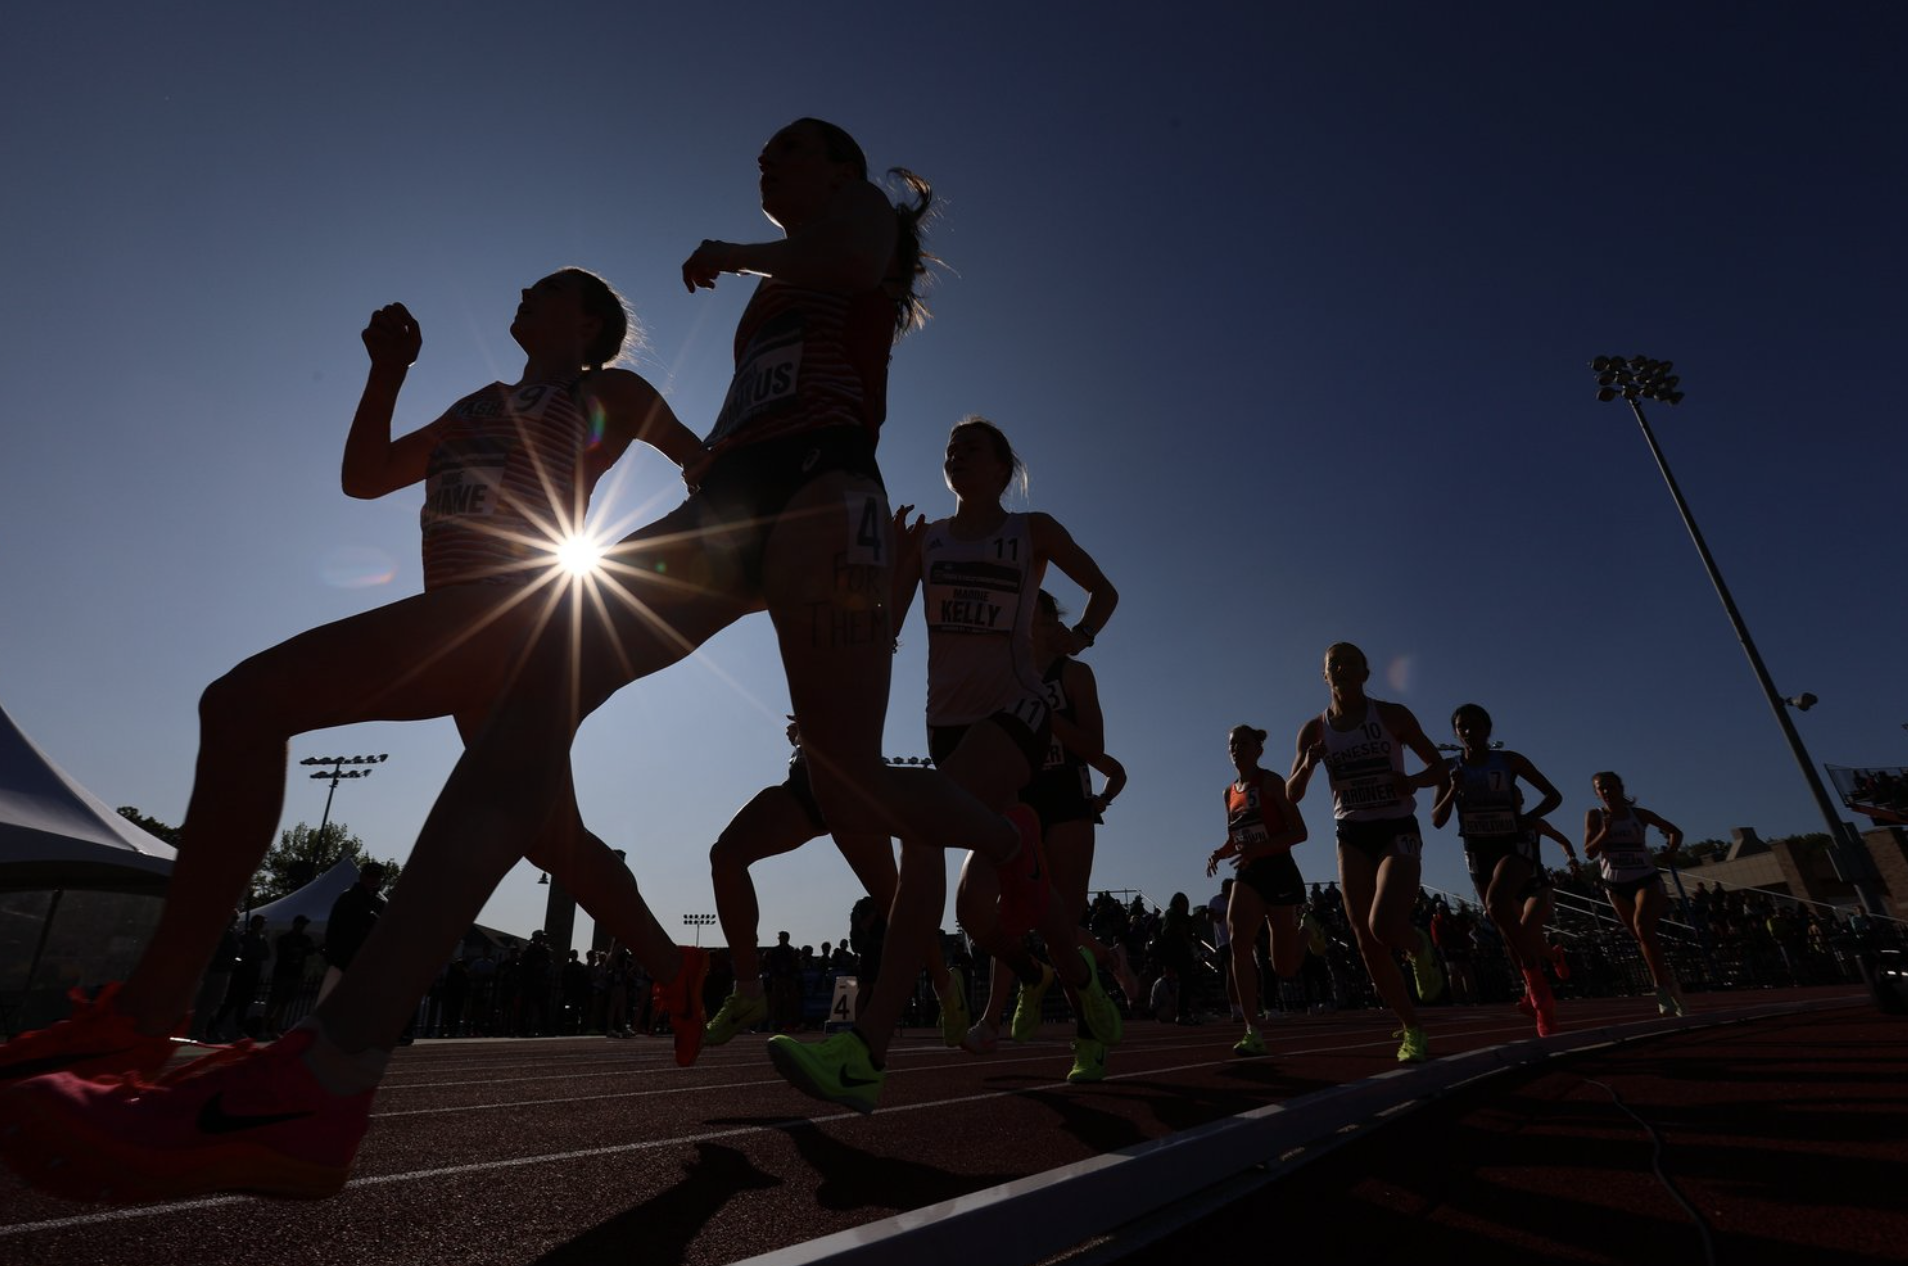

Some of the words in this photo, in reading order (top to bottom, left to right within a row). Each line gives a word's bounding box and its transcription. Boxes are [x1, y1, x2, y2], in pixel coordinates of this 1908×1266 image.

[519, 386, 547, 411] 9
[857, 497, 882, 561] 4
[994, 538, 1018, 561] 11
[803, 601, 889, 647] THEM
[941, 600, 1001, 627] KELLY
[1047, 684, 1060, 709] 3
[1360, 722, 1381, 740] 10
[1490, 771, 1501, 789] 7
[1248, 789, 1257, 806] 5
[1341, 783, 1397, 805] ARDNER
[834, 994, 850, 1020] 4
